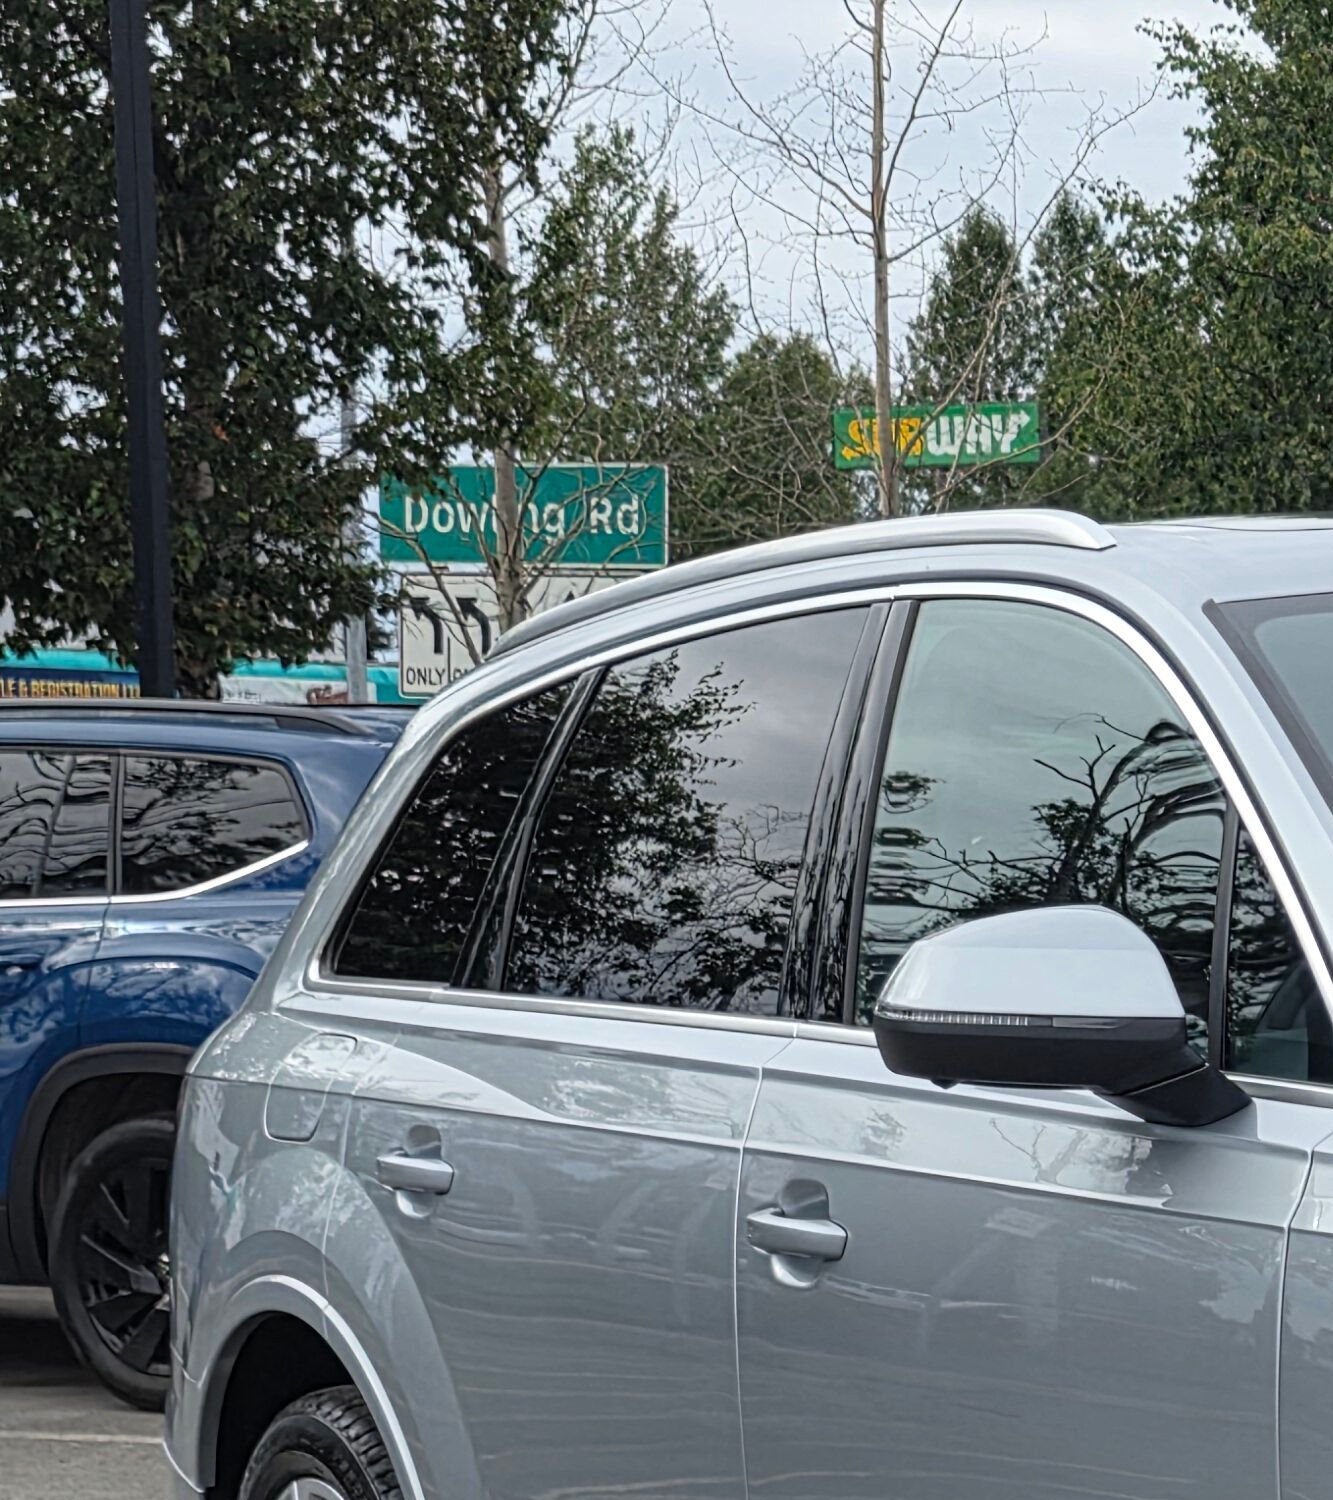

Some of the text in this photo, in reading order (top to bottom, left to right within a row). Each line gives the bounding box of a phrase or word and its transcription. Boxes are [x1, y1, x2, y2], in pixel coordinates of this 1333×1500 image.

[404, 493, 639, 548] Dowlng Rd
[406, 666, 445, 686] ONLY
